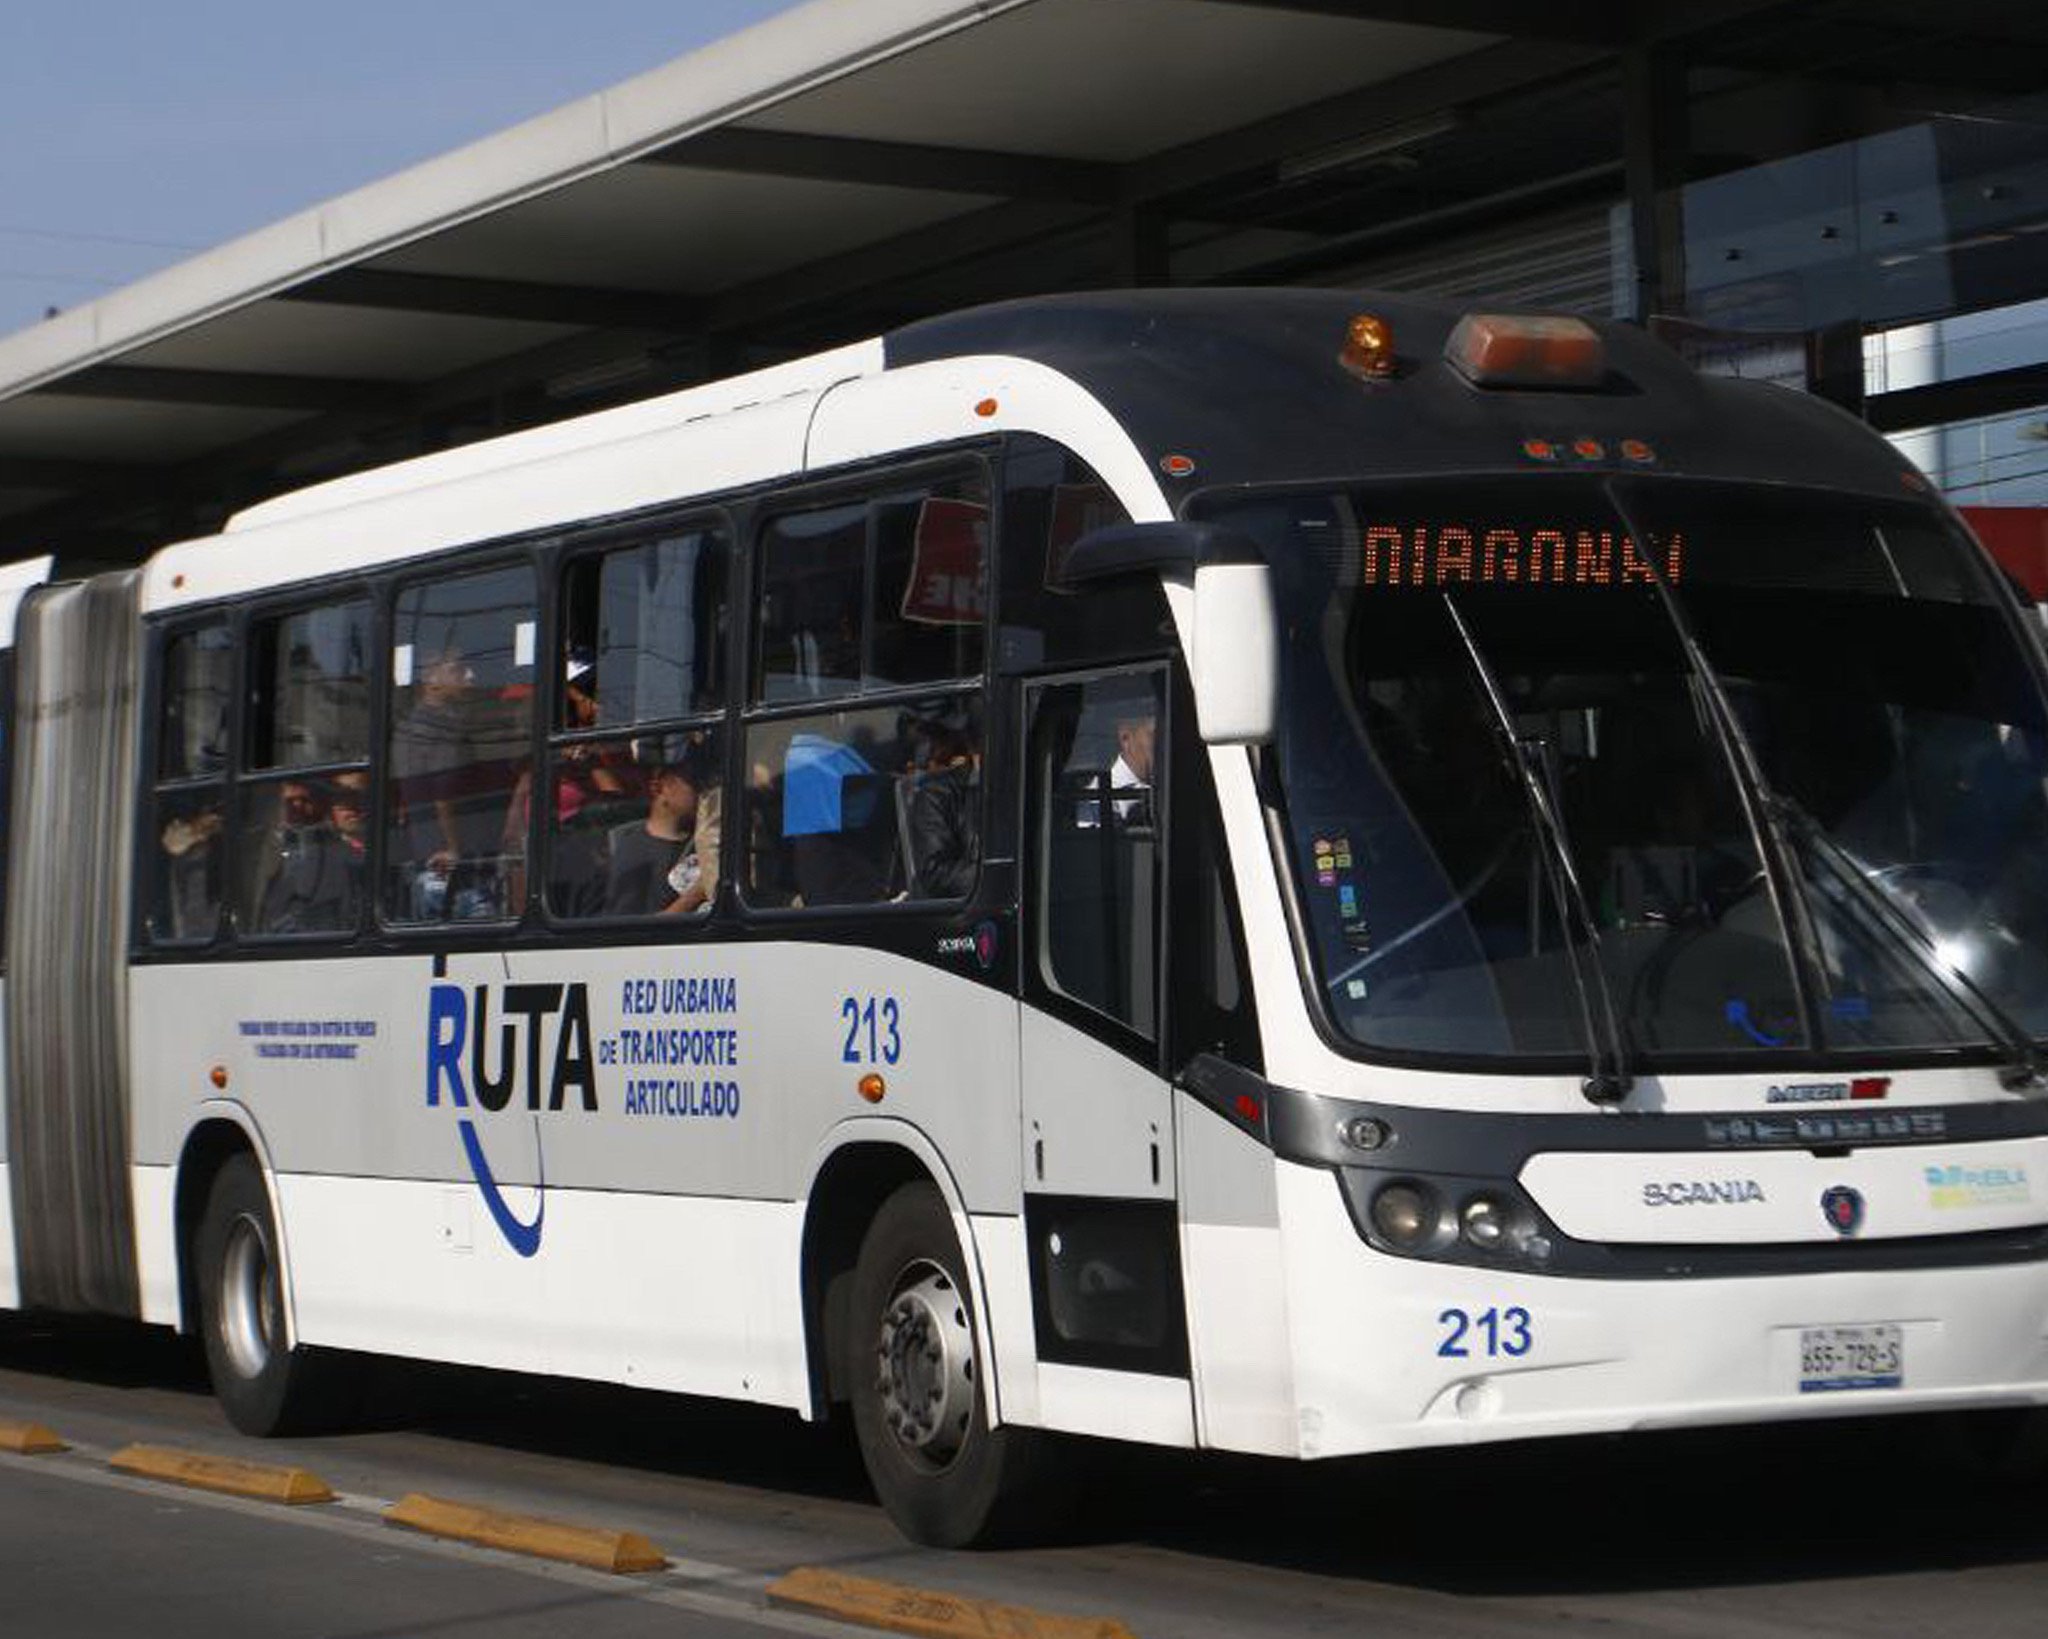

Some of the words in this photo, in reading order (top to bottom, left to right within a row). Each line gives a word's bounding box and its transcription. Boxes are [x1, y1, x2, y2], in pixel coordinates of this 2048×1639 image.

[622, 979, 657, 1014] RED
[662, 978, 736, 1013] URBANA
[426, 982, 598, 1112] RUTA
[600, 1039, 617, 1064] DE
[620, 1030, 737, 1066] TRANSPORTE
[842, 996, 901, 1064] 213
[625, 1080, 740, 1118] ARTICULADO
[1643, 1180, 1765, 1206] SCANIA
[1438, 1306, 1532, 1357] 213
